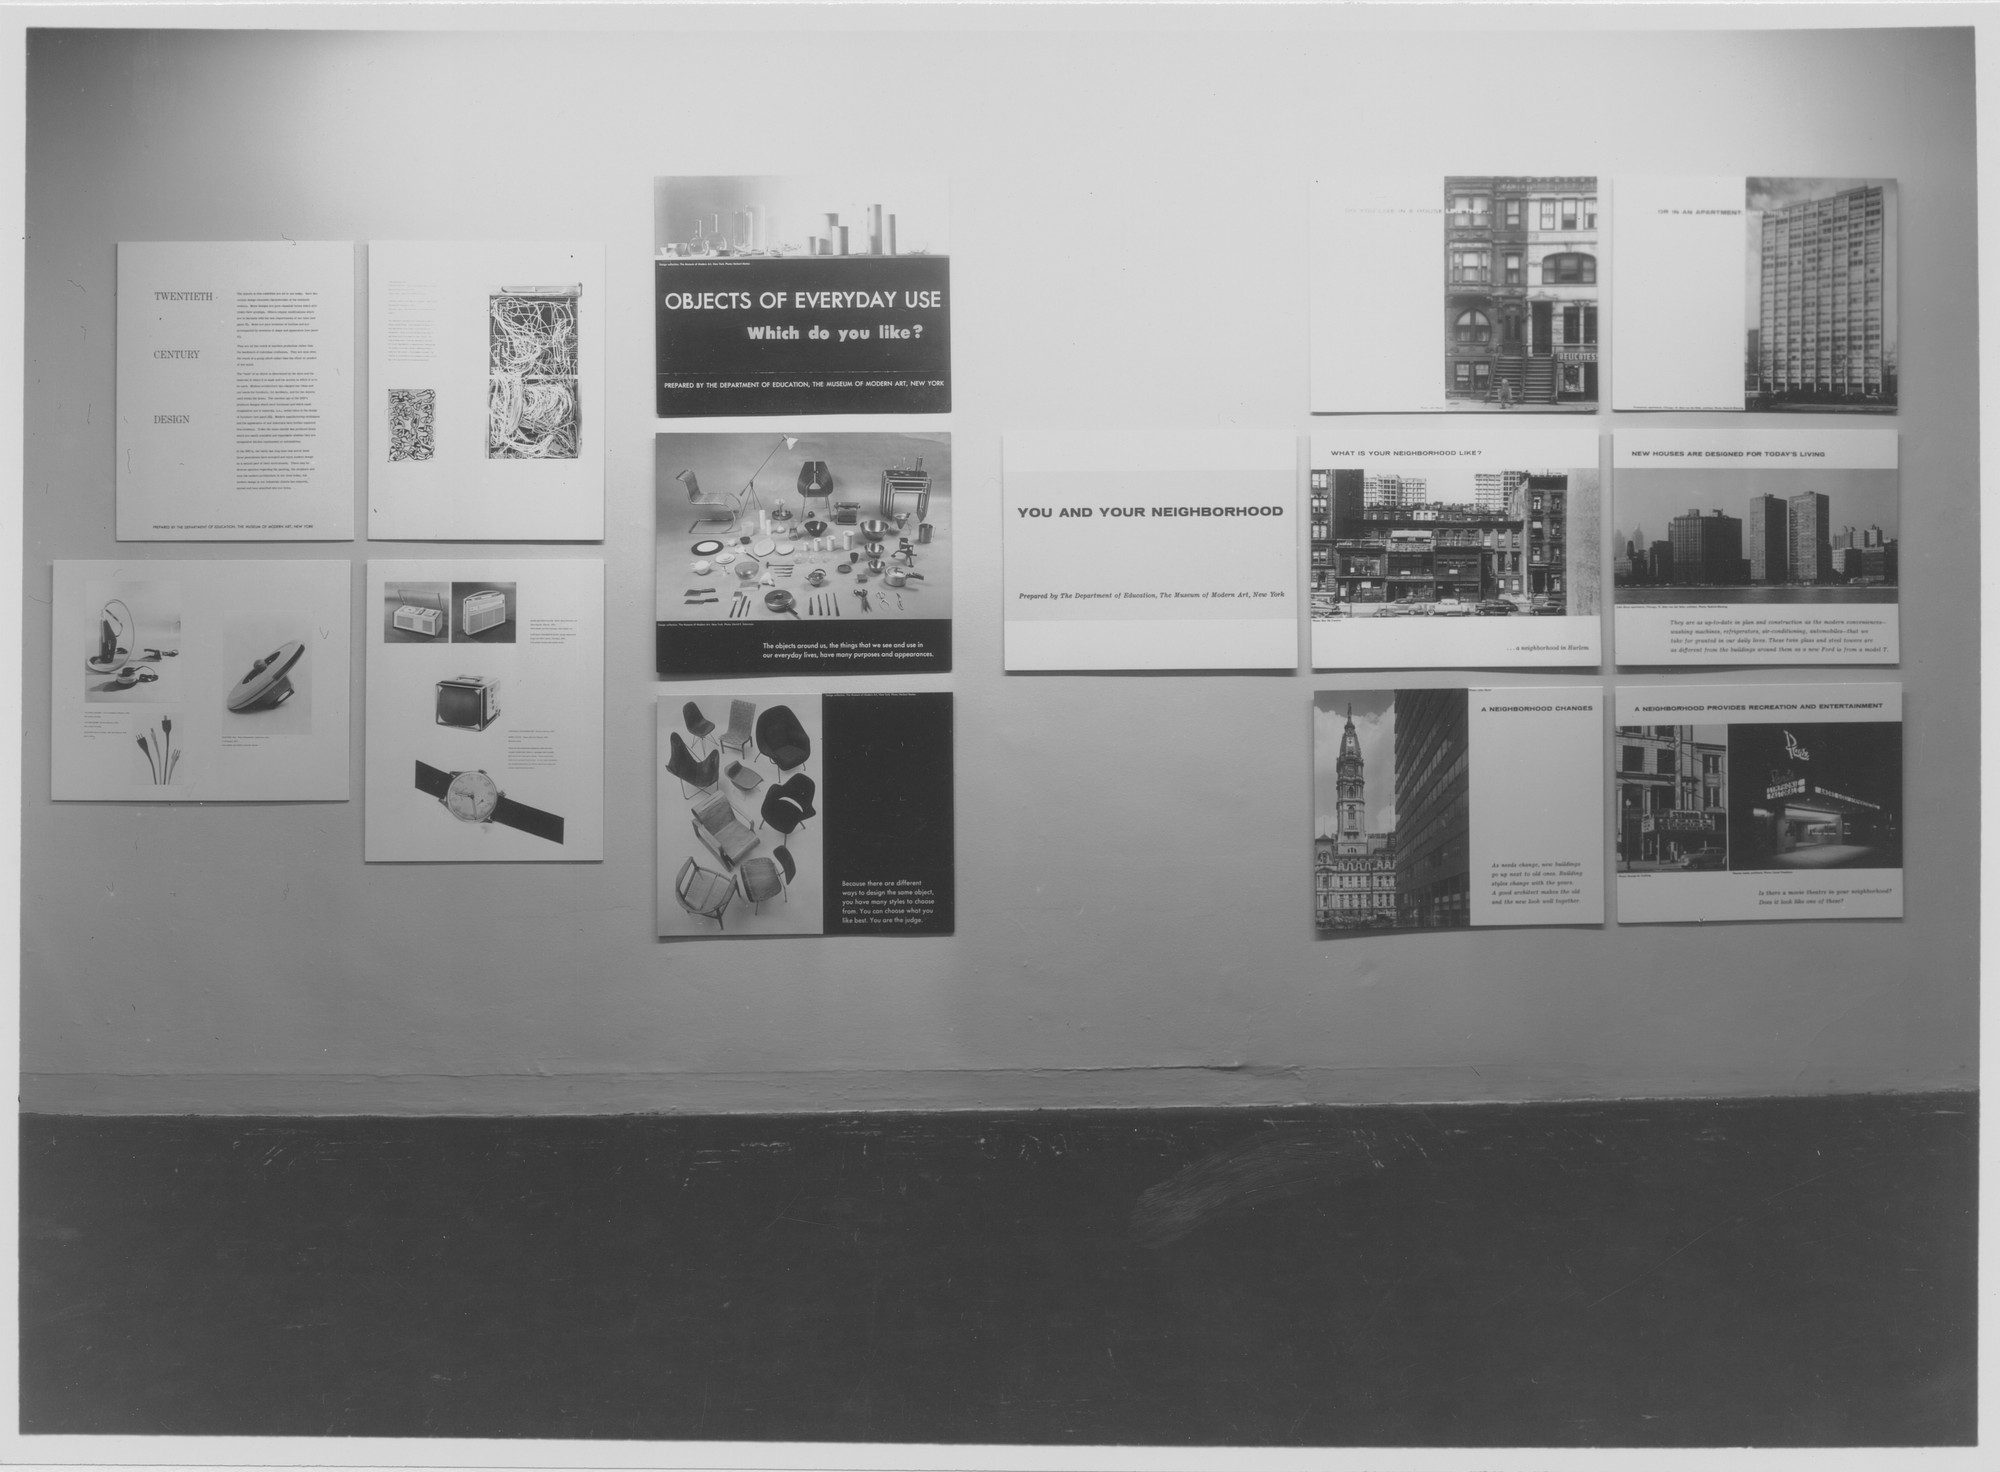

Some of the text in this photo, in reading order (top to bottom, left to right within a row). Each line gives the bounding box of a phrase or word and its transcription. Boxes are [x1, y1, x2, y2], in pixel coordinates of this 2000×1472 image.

[154, 291, 212, 301] TWENTIETH
[665, 290, 940, 309] OBJECTS OF EVERYDAY USE
[746, 324, 923, 342] Which do you like?
[153, 350, 200, 359] CENTURY
[154, 414, 189, 424] DESIGN
[1017, 506, 1283, 518] YOU AND YOUR NEIGHBORHOOD
[774, 642, 796, 650] objects
[774, 651, 802, 659] everyday
[866, 889, 885, 897] design
[888, 898, 905, 906] styles
